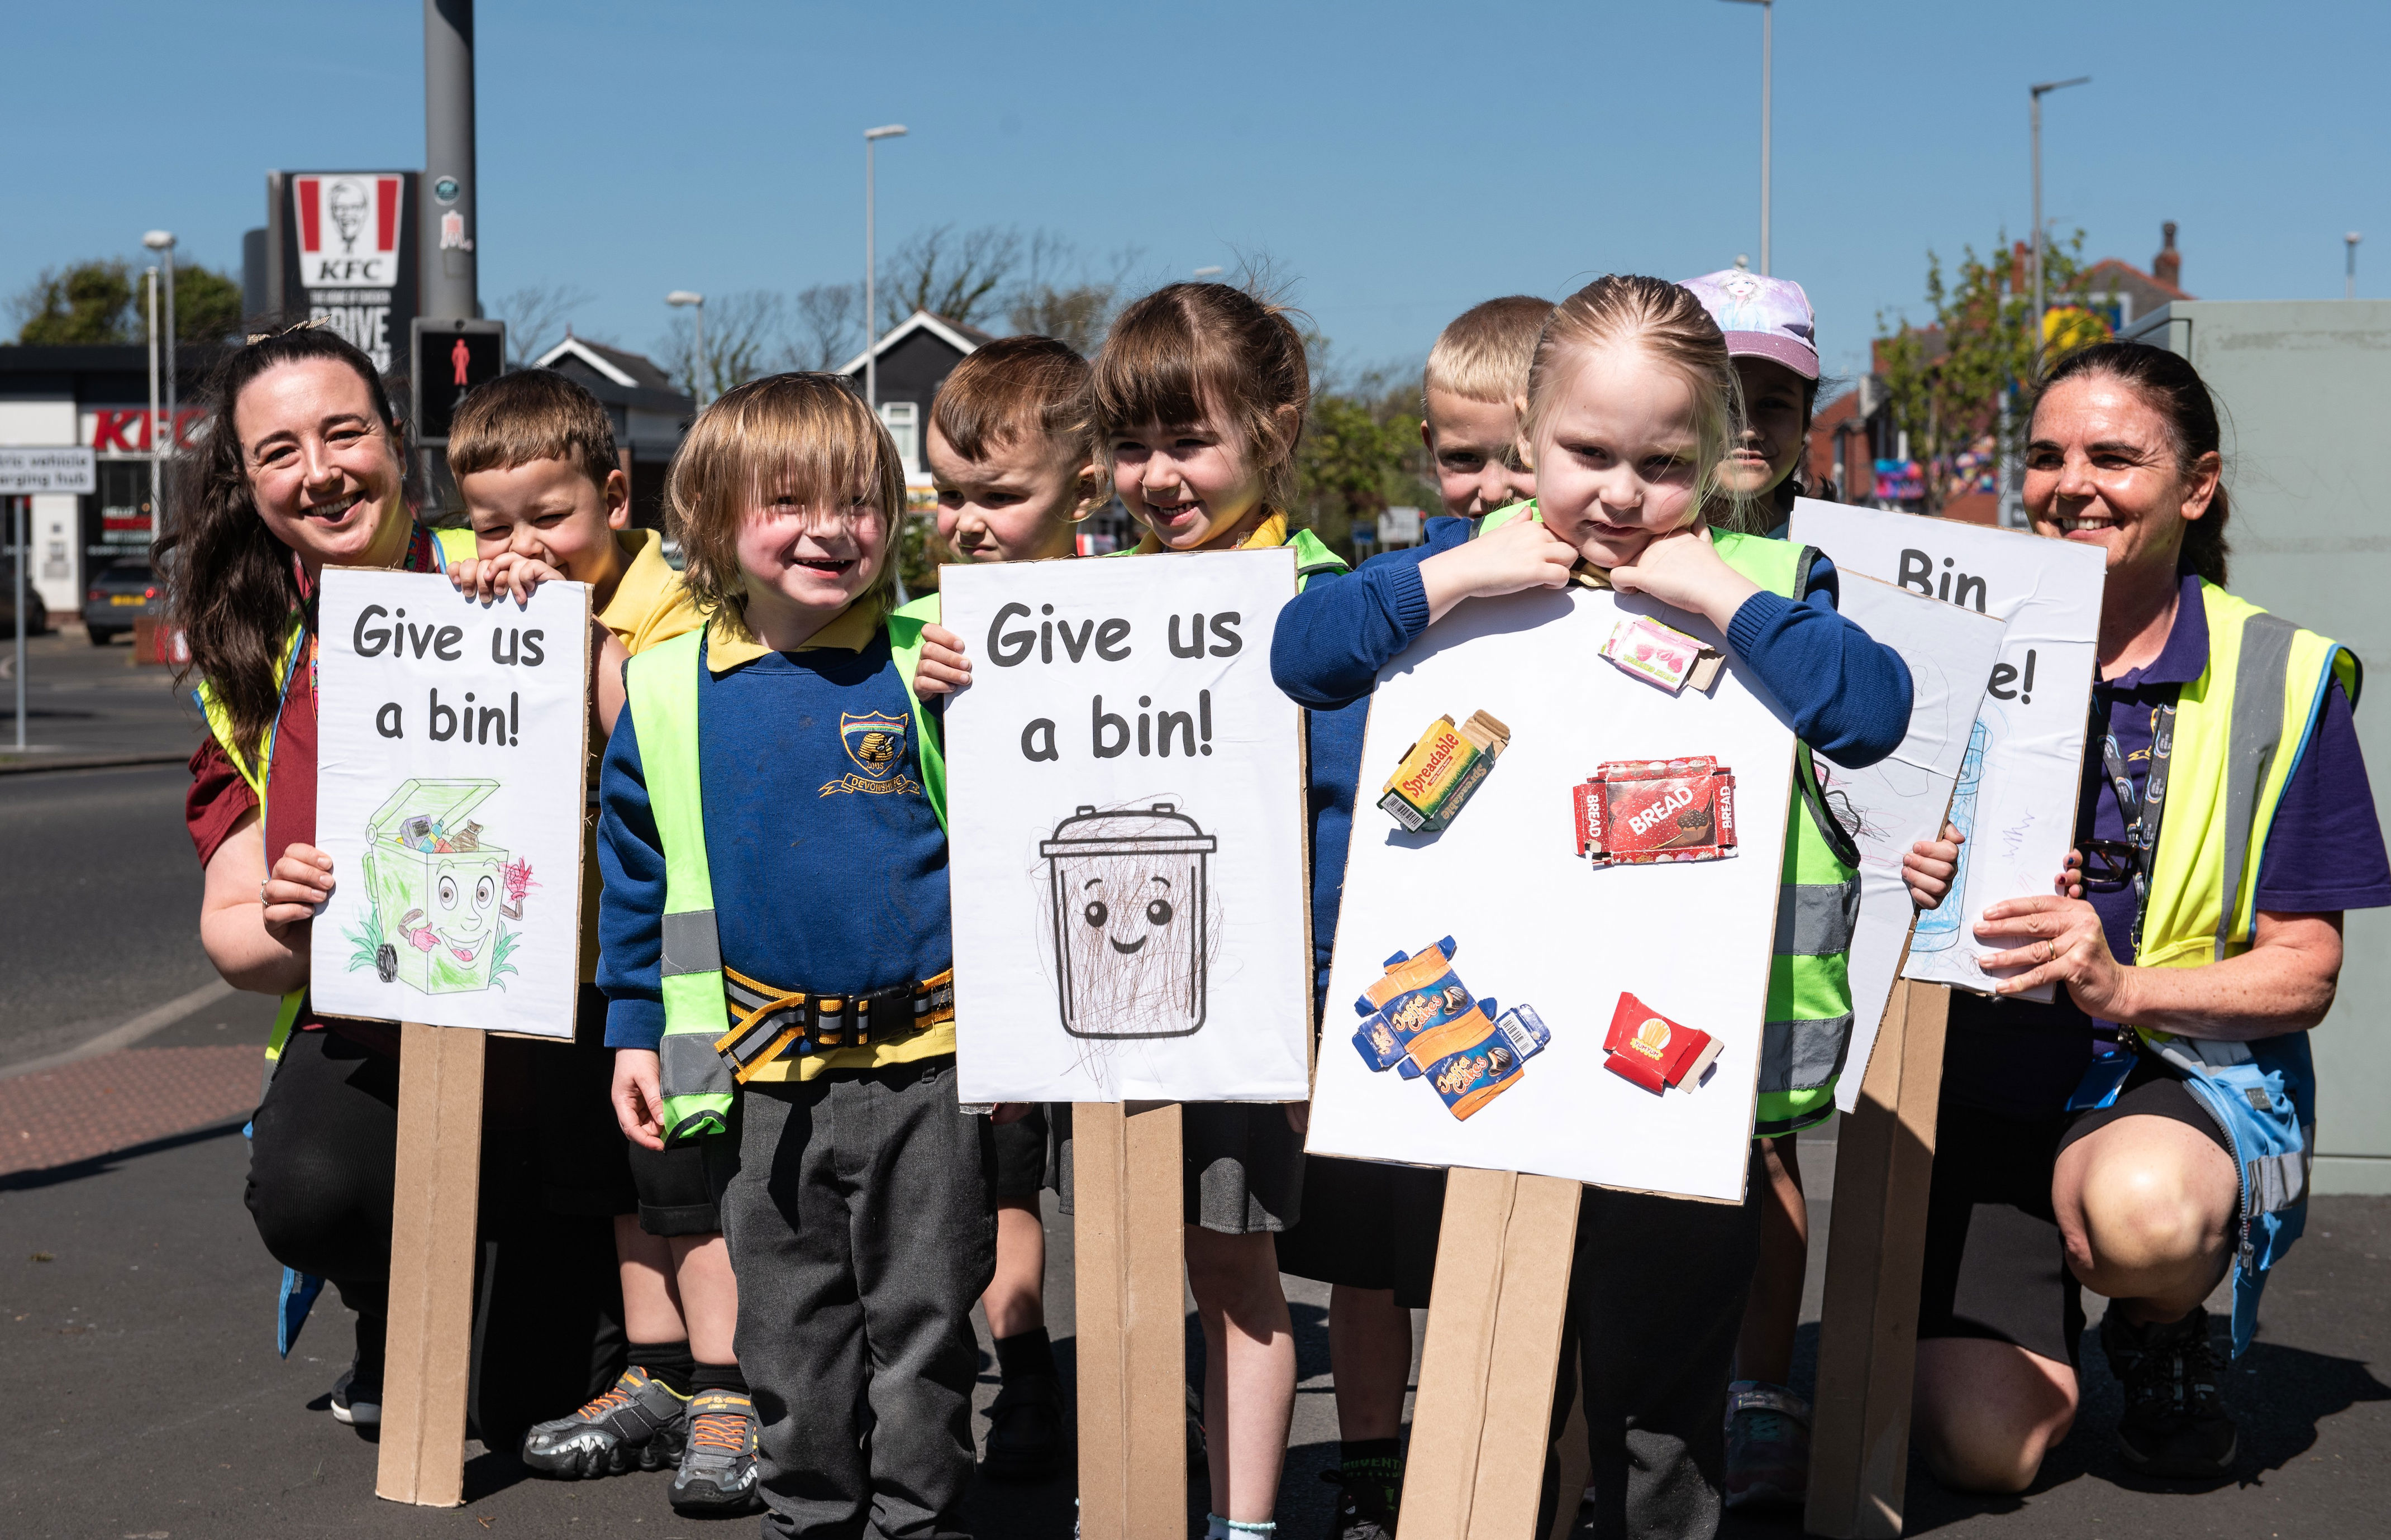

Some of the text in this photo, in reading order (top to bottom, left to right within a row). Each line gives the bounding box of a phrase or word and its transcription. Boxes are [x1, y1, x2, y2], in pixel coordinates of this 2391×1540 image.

[319, 260, 382, 279] KFC
[31, 452, 87, 466] vehicle
[56, 472, 87, 484] hub
[1898, 548, 1987, 614] Bin
[353, 604, 544, 666] Give us
[987, 602, 1243, 667] Give us
[1623, 654, 1655, 673] CRYSTAL
[1655, 669, 1678, 683] JELLY
[376, 688, 518, 747] a bin!
[1021, 689, 1212, 762] a bin!
[851, 777, 902, 792] DEVONSHIRE
[1402, 732, 1459, 798] Spreadable
[1440, 763, 1487, 820] Spreadable
[1628, 786, 1693, 836] BREAD
[1720, 786, 1733, 829] BREAD
[1587, 795, 1602, 837] BREAD
[1392, 994, 1426, 1032] Jaffa
[1408, 995, 1444, 1032] Cakes
[1635, 1041, 1659, 1056] YUM YUM
[1437, 1055, 1471, 1094] Jaffa
[1452, 1057, 1488, 1095] Cakes
